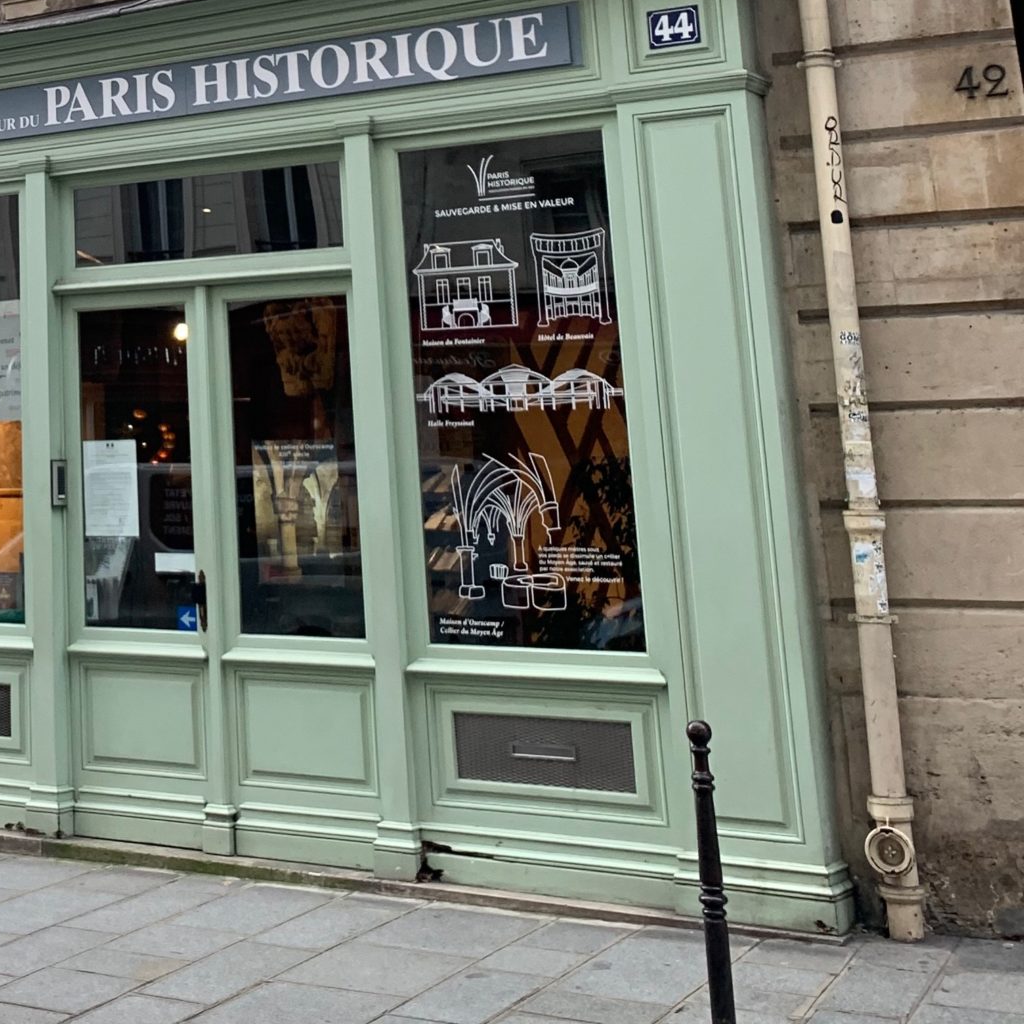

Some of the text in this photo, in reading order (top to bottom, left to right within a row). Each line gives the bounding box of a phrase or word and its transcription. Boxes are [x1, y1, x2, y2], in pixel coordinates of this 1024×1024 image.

[654, 13, 694, 42] 44
[43, 12, 548, 127] PARIS HISTORIQUE
[954, 64, 1009, 100] 42
[22, 114, 40, 129] DU
[487, 171, 510, 181] PARIS
[487, 176, 535, 188] HISTORIQUE
[434, 196, 575, 218] SAUVEGARDE & MISE EN VALEUR
[439, 617, 462, 626] Maison
[440, 626, 460, 635] Cellier
[470, 628, 490, 637] Moyen
